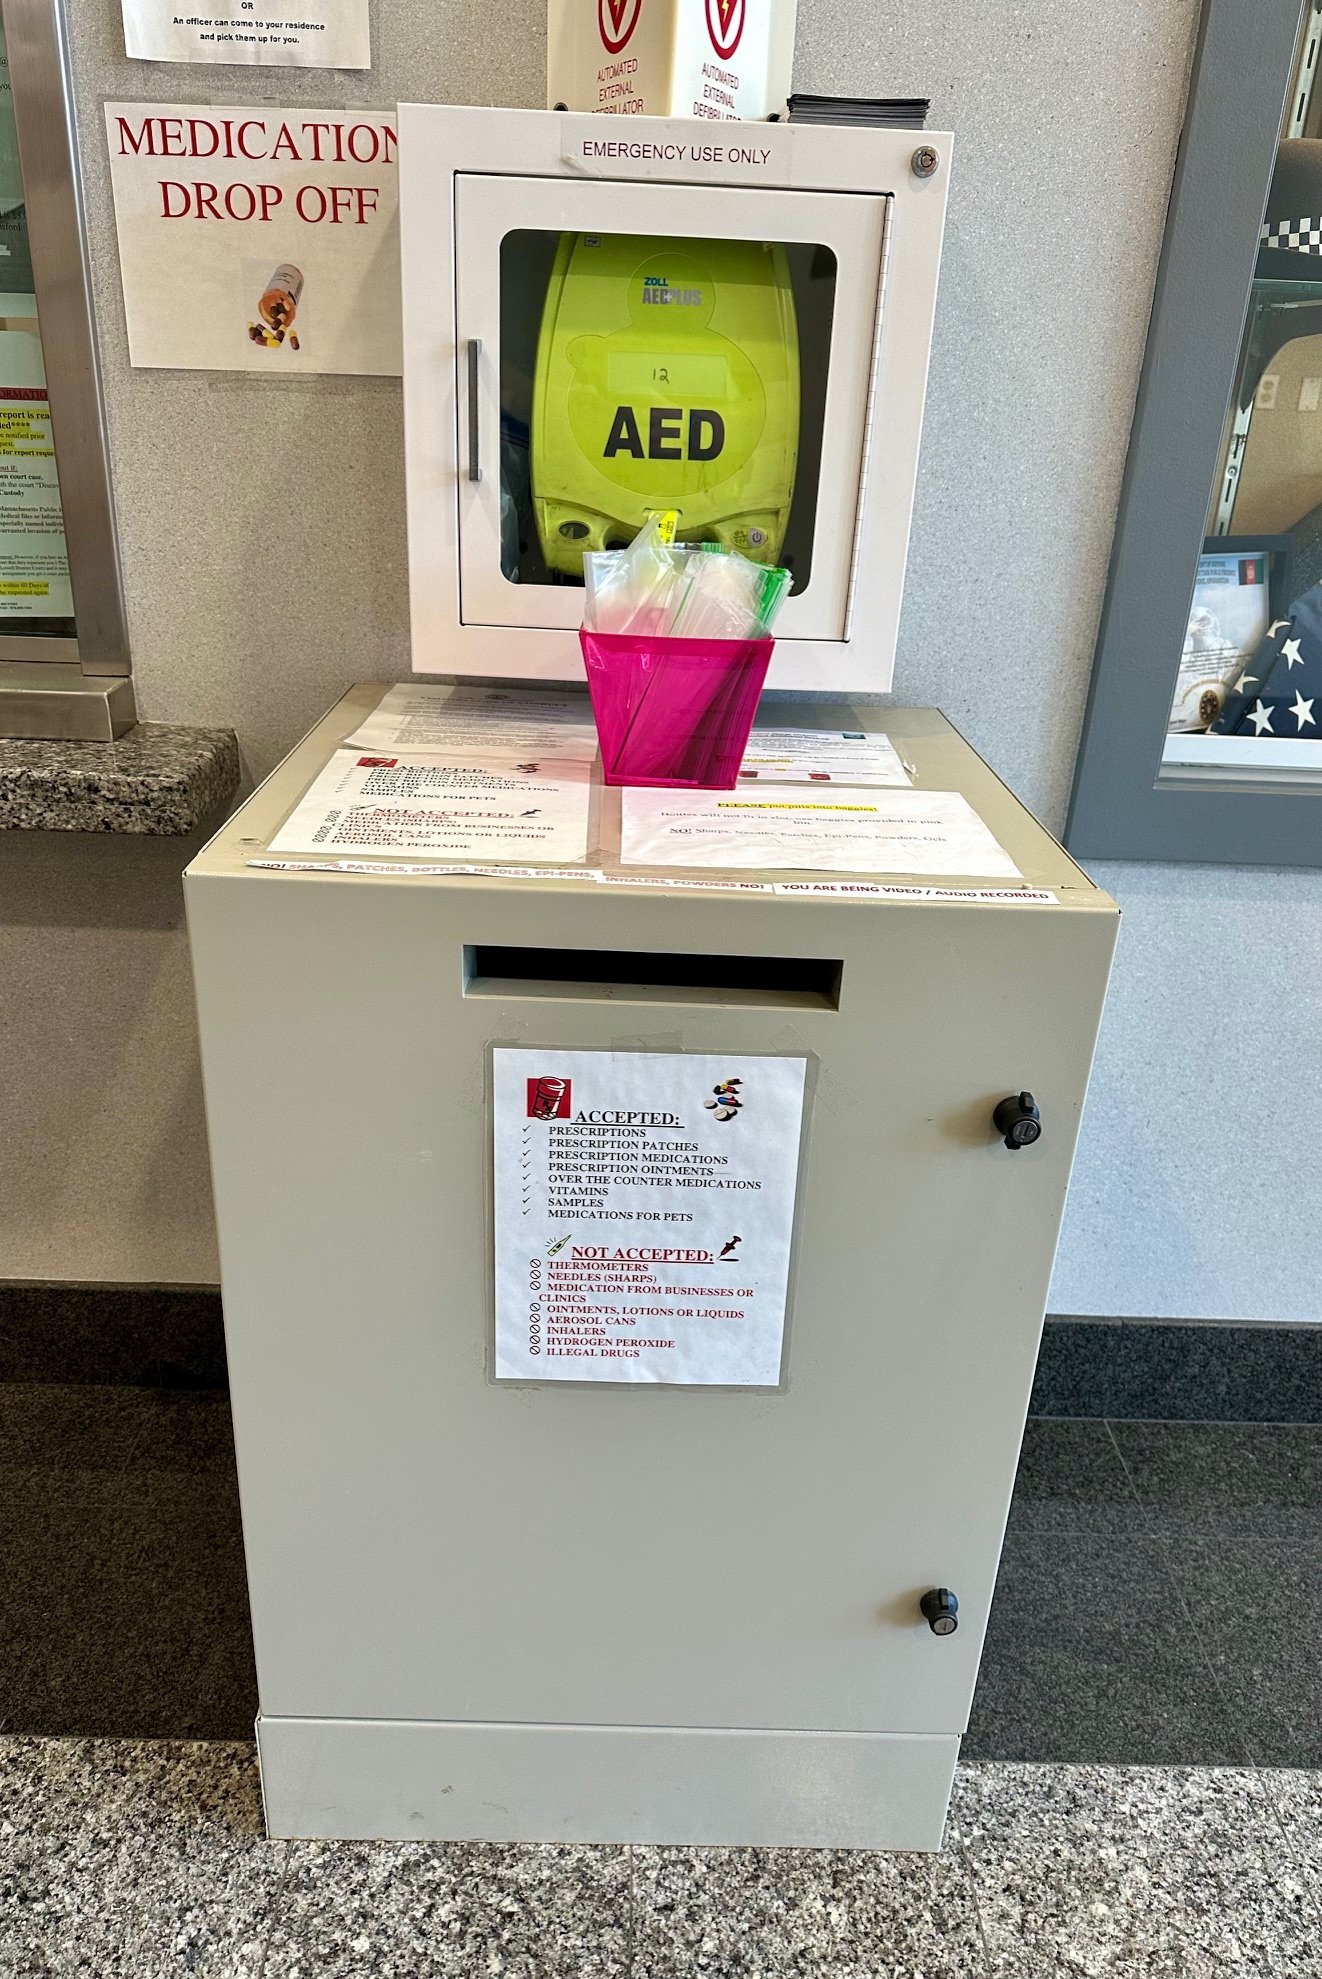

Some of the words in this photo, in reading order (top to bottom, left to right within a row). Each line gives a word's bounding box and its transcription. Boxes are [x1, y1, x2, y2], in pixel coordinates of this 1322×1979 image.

[241, 2, 255, 10] OR
[173, 16, 185, 25] An
[186, 17, 213, 26] officer
[231, 19, 254, 28] come
[255, 20, 264, 28] to
[266, 21, 283, 30] your
[284, 21, 326, 31] residence
[200, 33, 215, 41] and
[217, 33, 234, 42] pick
[235, 34, 256, 42] them
[270, 34, 281, 42] for
[283, 36, 300, 44] you.
[597, 58, 638, 83] AUTOMATED
[701, 62, 739, 90] AUTOMATED
[599, 80, 634, 102] EXTERNAL
[703, 84, 735, 109] EXTERNAL
[583, 141, 688, 160] EMERGENCY
[691, 146, 723, 162] USE
[729, 148, 771, 164] ONLY
[158, 181, 283, 221] DROP
[296, 186, 380, 225] OFF
[644, 277, 669, 287] ZOLL
[652, 368, 670, 385] 12
[602, 405, 726, 462] AED
[347, 864, 408, 873] PATCHES,
[474, 868, 532, 876] NEEDLES,
[535, 870, 595, 878] EPI-PENS,
[605, 877, 670, 885] INHALERS,
[673, 880, 737, 888] POWDERS
[935, 890, 977, 898] AUDIO
[574, 1110, 680, 1125] ACCEPTED:
[548, 1126, 647, 1137] PRESCRIPTIONS
[548, 1138, 639, 1150] PRESCRIPTION
[642, 1141, 699, 1151] PATCHES
[548, 1150, 639, 1162] PRESCRIPTION
[642, 1154, 729, 1165] MEDICATIONS
[548, 1162, 639, 1173] PRESCRIPTION
[641, 1165, 714, 1176] OINTMENTS
[548, 1174, 582, 1184] OVER
[585, 1175, 611, 1185] THE
[614, 1176, 672, 1187] COUNTER
[675, 1179, 762, 1190] MEDICATIONS
[548, 1186, 609, 1196] VITAMINS
[548, 1197, 604, 1208] SAMPLES
[548, 1209, 633, 1220] MEDICATIONS
[636, 1211, 661, 1221] FOR
[664, 1212, 693, 1222] PETS
[571, 1246, 609, 1258] NOT
[613, 1247, 714, 1262] ACCEPTED:
[547, 1261, 649, 1272] THERMOMETERS
[547, 1272, 601, 1281] NEEDLES
[604, 1273, 657, 1284] (SHARPS)
[547, 1283, 624, 1293] MEDICATION
[627, 1285, 662, 1295] FROM
[665, 1286, 734, 1297] BUSINESSES
[737, 1288, 754, 1298] OR
[538, 1293, 587, 1303] CLINICS
[547, 1305, 620, 1316] OINTMENTS,
[622, 1306, 674, 1316] LOTIONS
[677, 1308, 693, 1317] OR
[697, 1309, 744, 1320] LIQUIDS
[547, 1316, 602, 1325] AEROSOL
[605, 1317, 636, 1326] CANS
[547, 1326, 606, 1336] INHALERS
[547, 1337, 613, 1347] HYDROGEN
[616, 1338, 676, 1348] PEROXIDE
[547, 1347, 598, 1357] ILLEGAL
[600, 1349, 641, 1358] DRUGS
